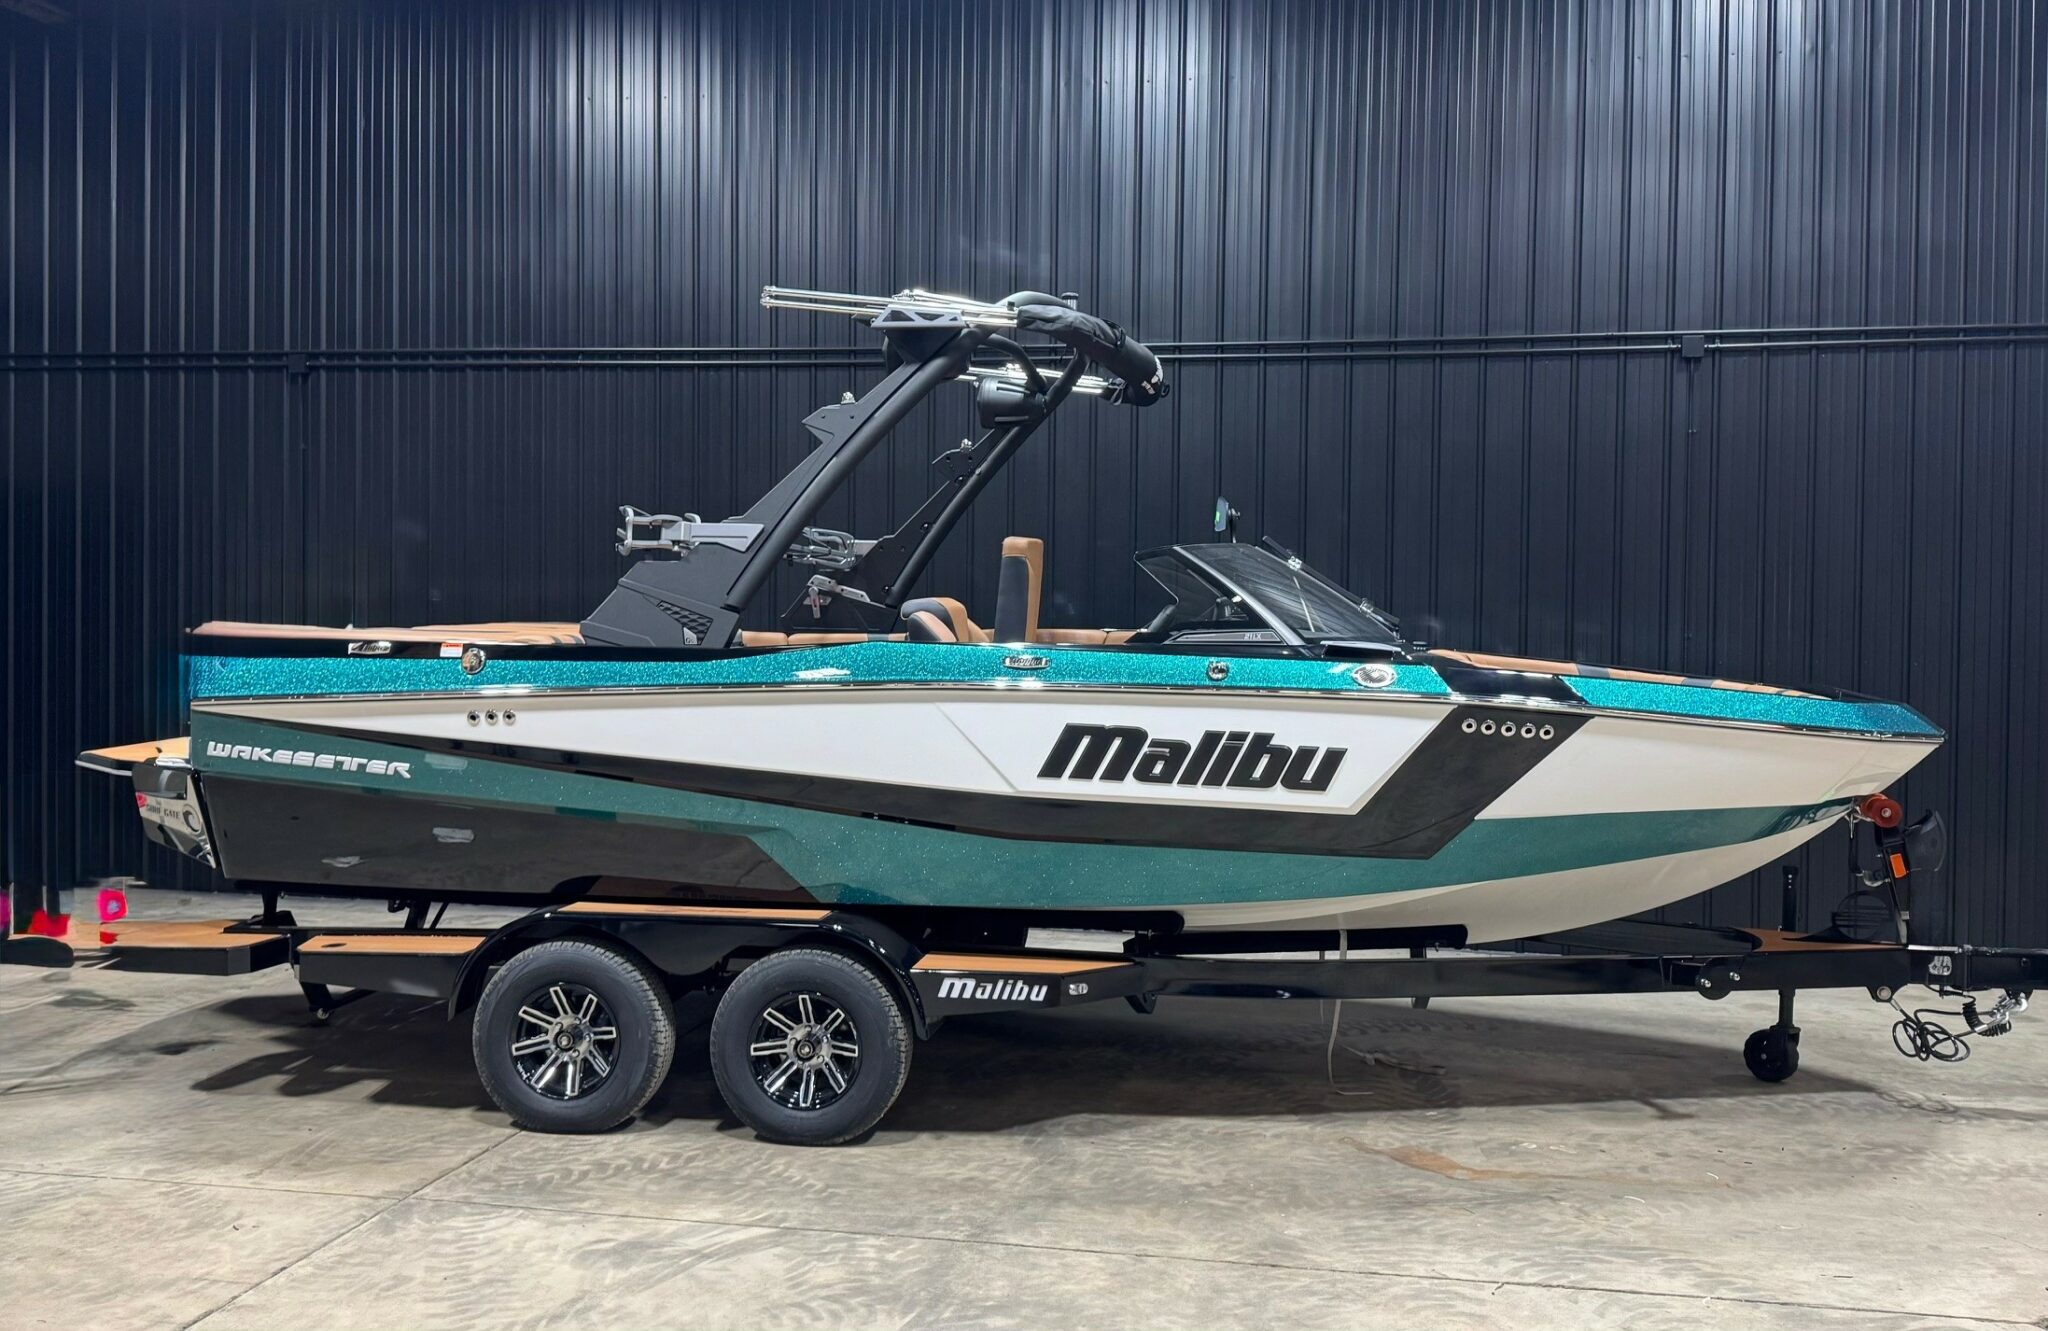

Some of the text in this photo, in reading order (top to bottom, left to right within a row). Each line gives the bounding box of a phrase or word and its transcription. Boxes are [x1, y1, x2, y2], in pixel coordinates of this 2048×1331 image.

[206, 740, 412, 779] WAKESETTER
[1037, 722, 1348, 793] Malibu
[937, 977, 1048, 1002] Malibu
